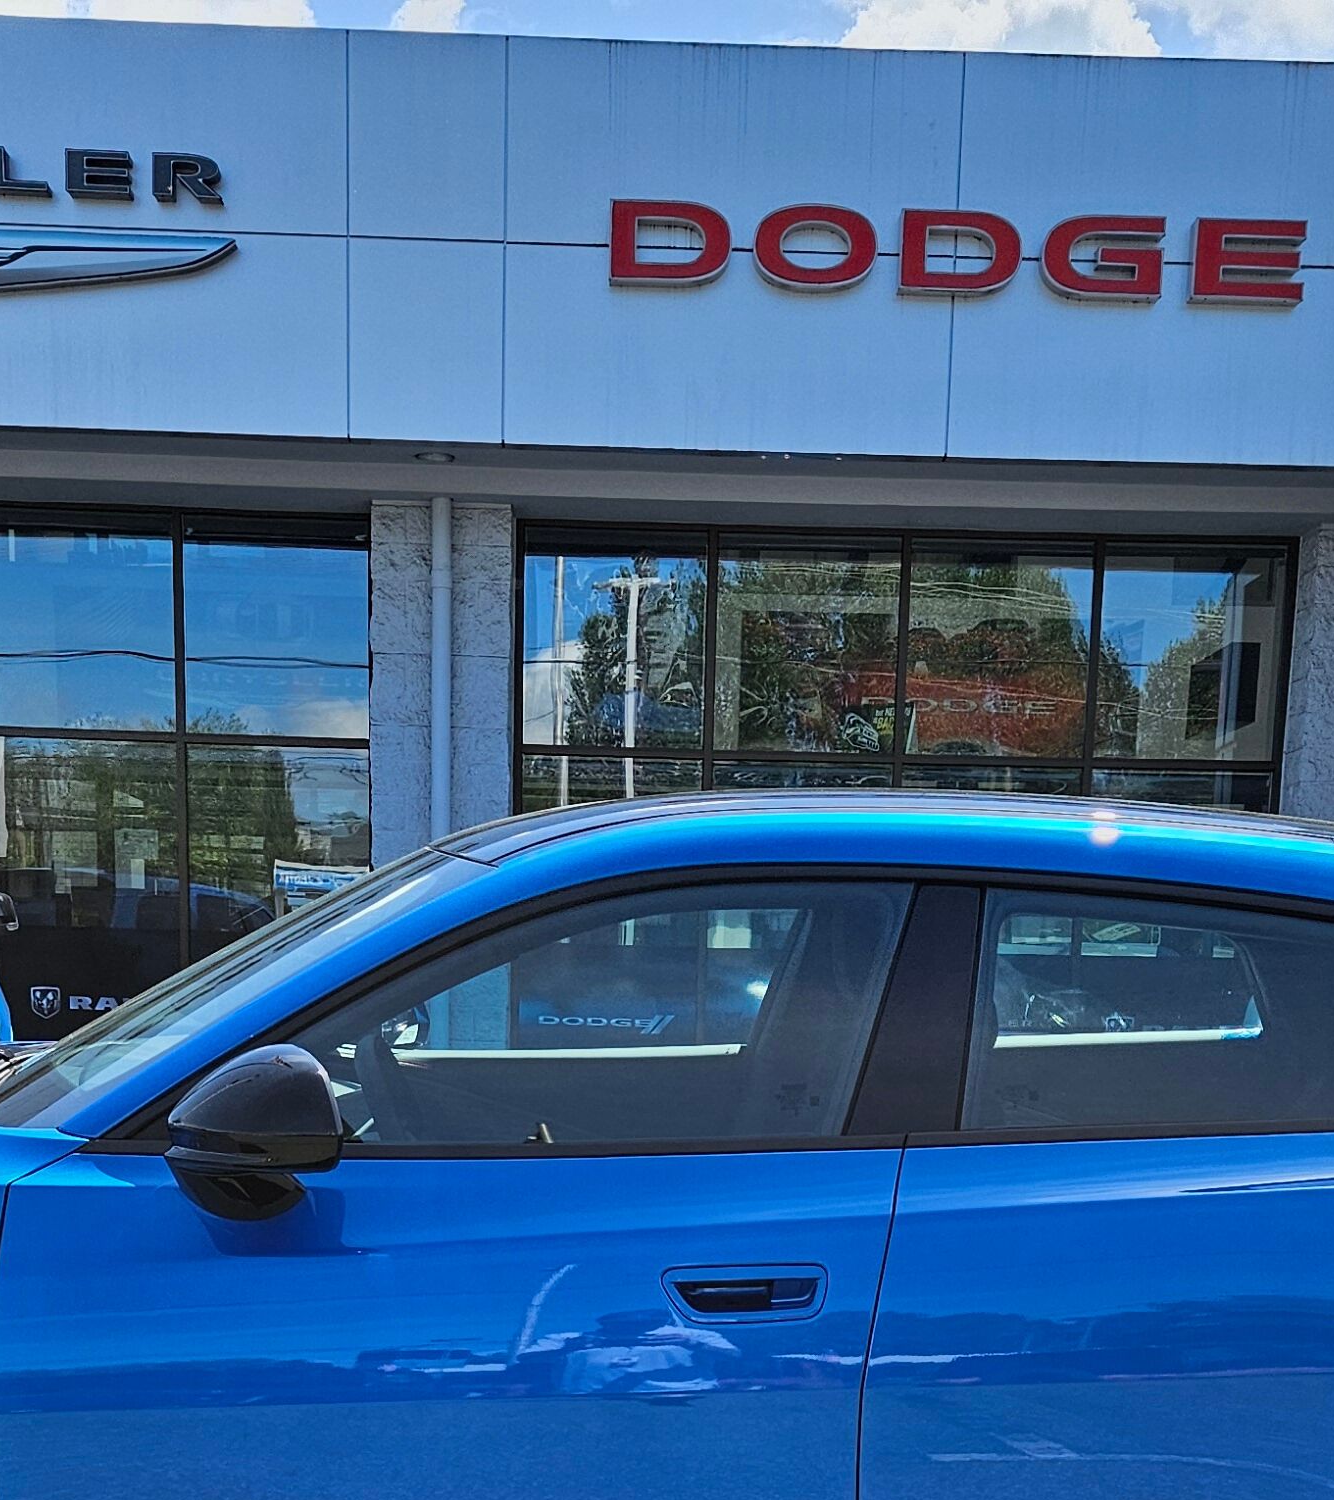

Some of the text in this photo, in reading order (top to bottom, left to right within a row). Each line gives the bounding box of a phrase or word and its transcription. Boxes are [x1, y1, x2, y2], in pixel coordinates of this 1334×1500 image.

[609, 198, 1309, 306] DODGE
[69, 995, 130, 1011] RA
[538, 1015, 653, 1028] DODGE
